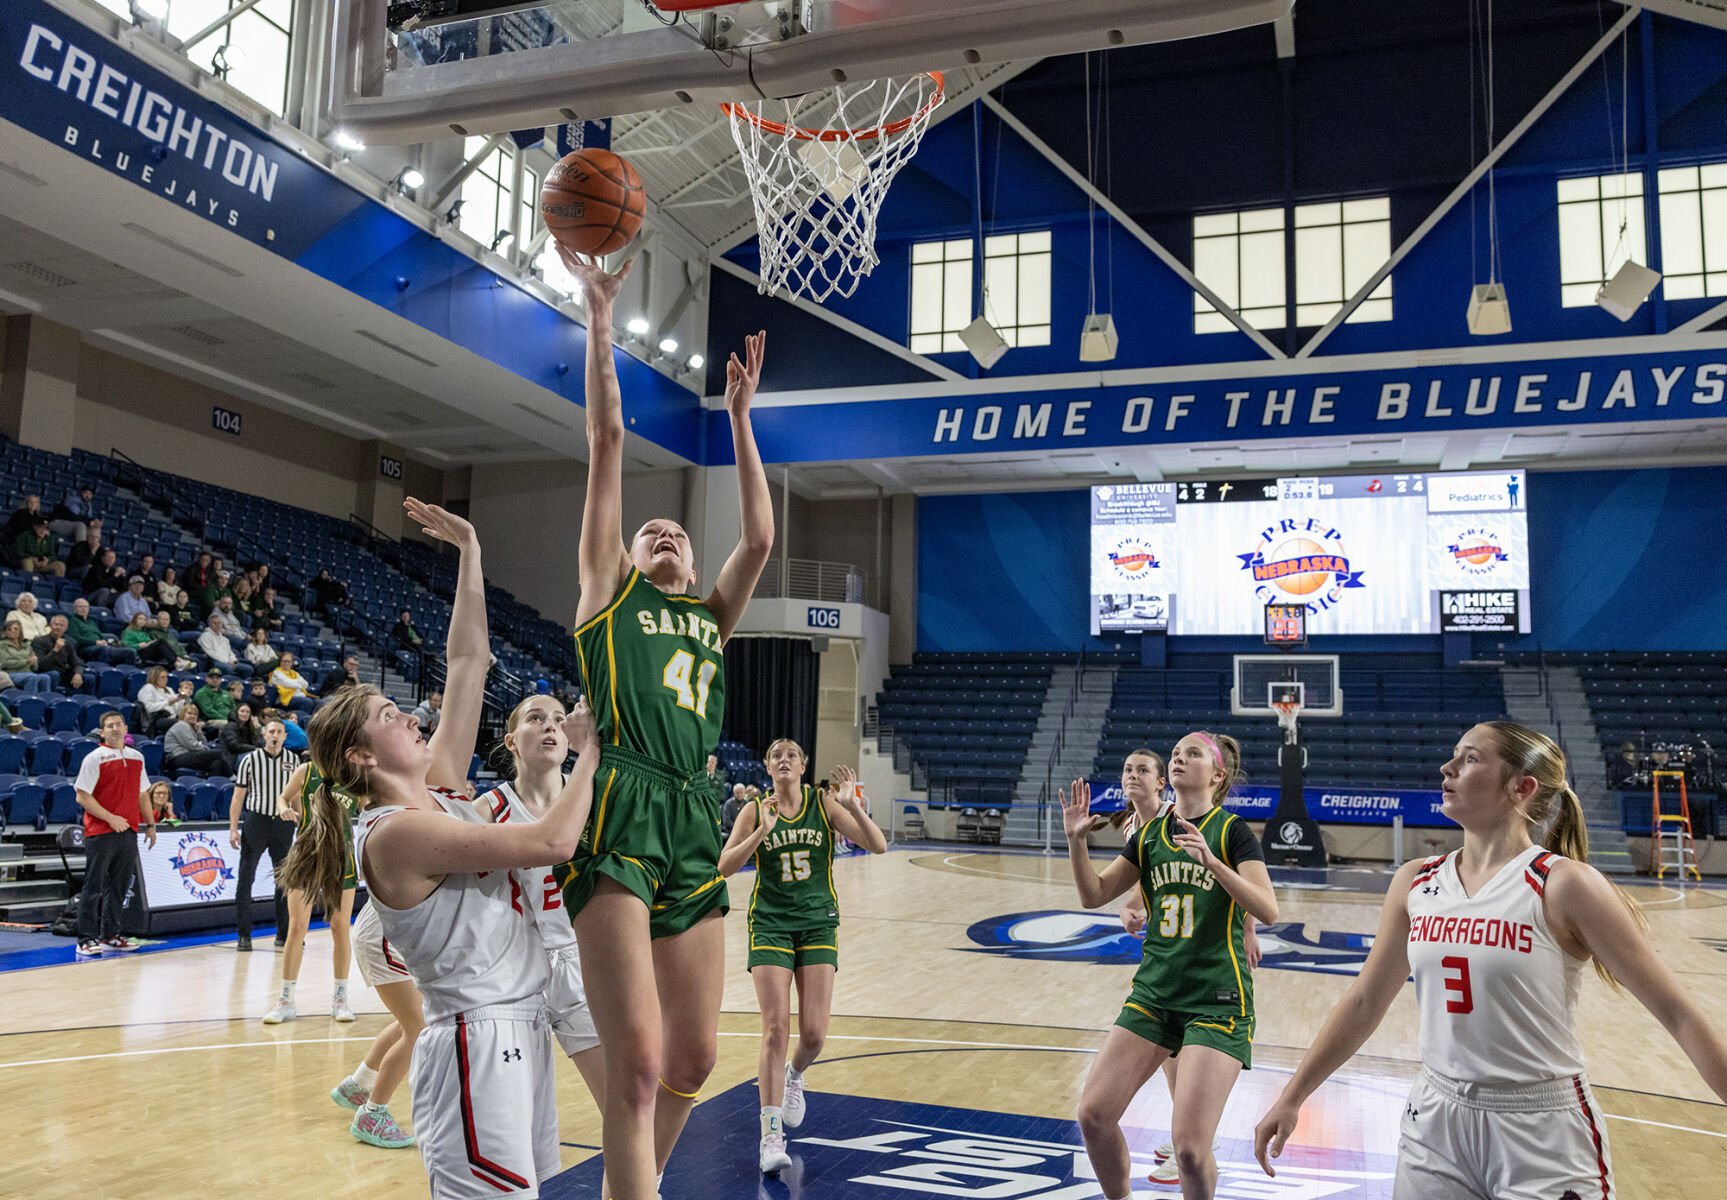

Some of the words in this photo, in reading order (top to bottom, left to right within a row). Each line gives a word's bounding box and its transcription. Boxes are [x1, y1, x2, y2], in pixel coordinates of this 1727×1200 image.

[20, 24, 279, 202] CREIGHTON
[64, 126, 239, 226] BLUEJAYS
[932, 401, 1092, 443] HOME
[1121, 395, 1196, 433] OF
[1224, 386, 1341, 428] THE
[1376, 363, 1727, 421] BLUEJAYS
[214, 409, 241, 433] 104
[381, 458, 401, 478] 105
[1116, 483, 1172, 495] BELLEVUE
[1178, 489, 1189, 500] 4
[1195, 489, 1205, 500] 2
[1262, 485, 1278, 498] 18
[1319, 484, 1334, 497] 19
[1397, 481, 1407, 493] 2
[1412, 480, 1424, 492] 4
[1449, 493, 1503, 502] Pediatrics
[1261, 518, 1342, 543] PREP
[1254, 556, 1347, 580] NEBRASKA
[1465, 592, 1515, 607] HIKE
[809, 608, 839, 627] 106
[663, 648, 717, 720] 41
[1321, 794, 1400, 809] CREIGHTON
[178, 832, 218, 850] PREP
[763, 828, 823, 852] SAINTES
[780, 850, 812, 882] 15
[183, 880, 226, 901] CLASSIC
[1159, 894, 1195, 938] 31
[1409, 915, 1533, 954] ENDRAGONS
[1441, 956, 1474, 1014] 3
